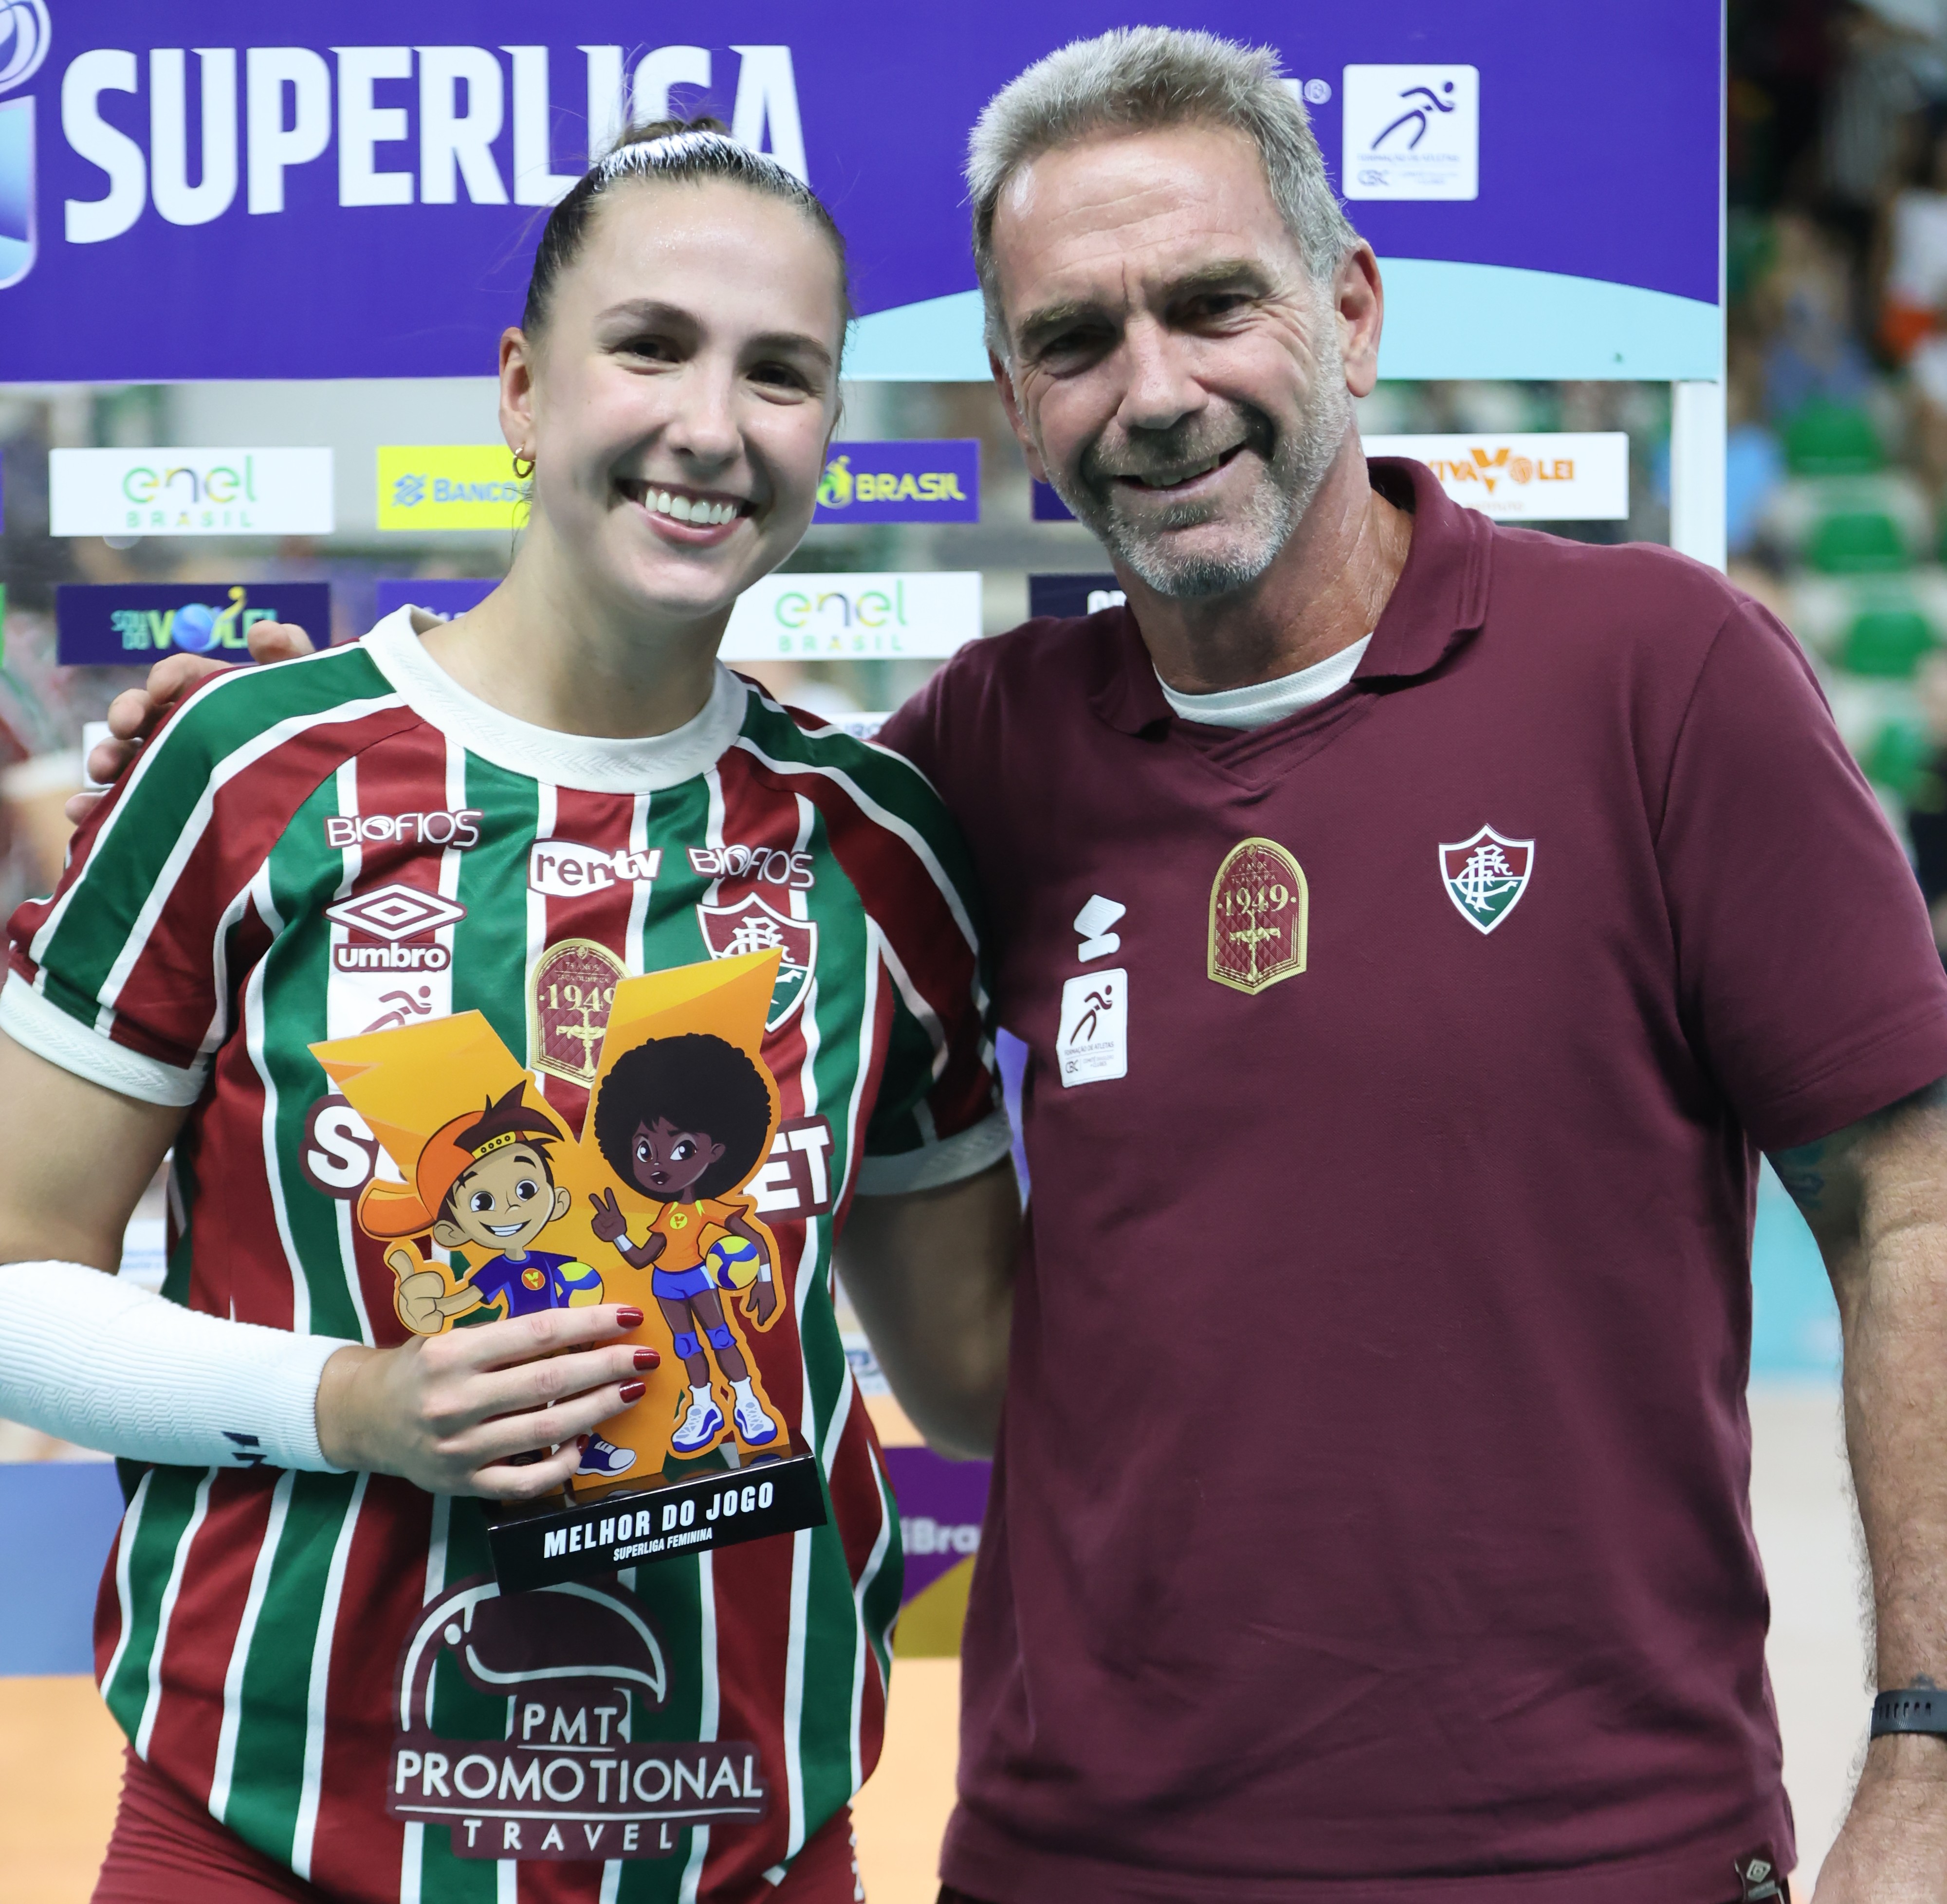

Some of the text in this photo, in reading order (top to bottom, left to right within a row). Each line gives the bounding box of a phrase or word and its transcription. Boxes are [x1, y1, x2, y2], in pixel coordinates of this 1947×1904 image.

[123, 455, 257, 503] enel
[855, 472, 968, 502] BRASIL
[126, 511, 254, 528] BRASIL
[775, 579, 909, 628] enel
[779, 635, 904, 652] BRASIL
[327, 811, 482, 847] BIOFIOS
[689, 844, 815, 888] BIOFIOS
[1224, 884, 1289, 916] 1949
[338, 943, 446, 968] umbro
[546, 983, 616, 1013] 1949
[1094, 1041, 1114, 1049] ATLETAS
[544, 1482, 774, 1558] MELHOR DO JOGO
[613, 1526, 713, 1561] SUPERLIGA FEMININA
[522, 1703, 618, 1745] PMT
[395, 1750, 763, 1804] PROMOTIONAL
[463, 1819, 672, 1851] TRAVEL
